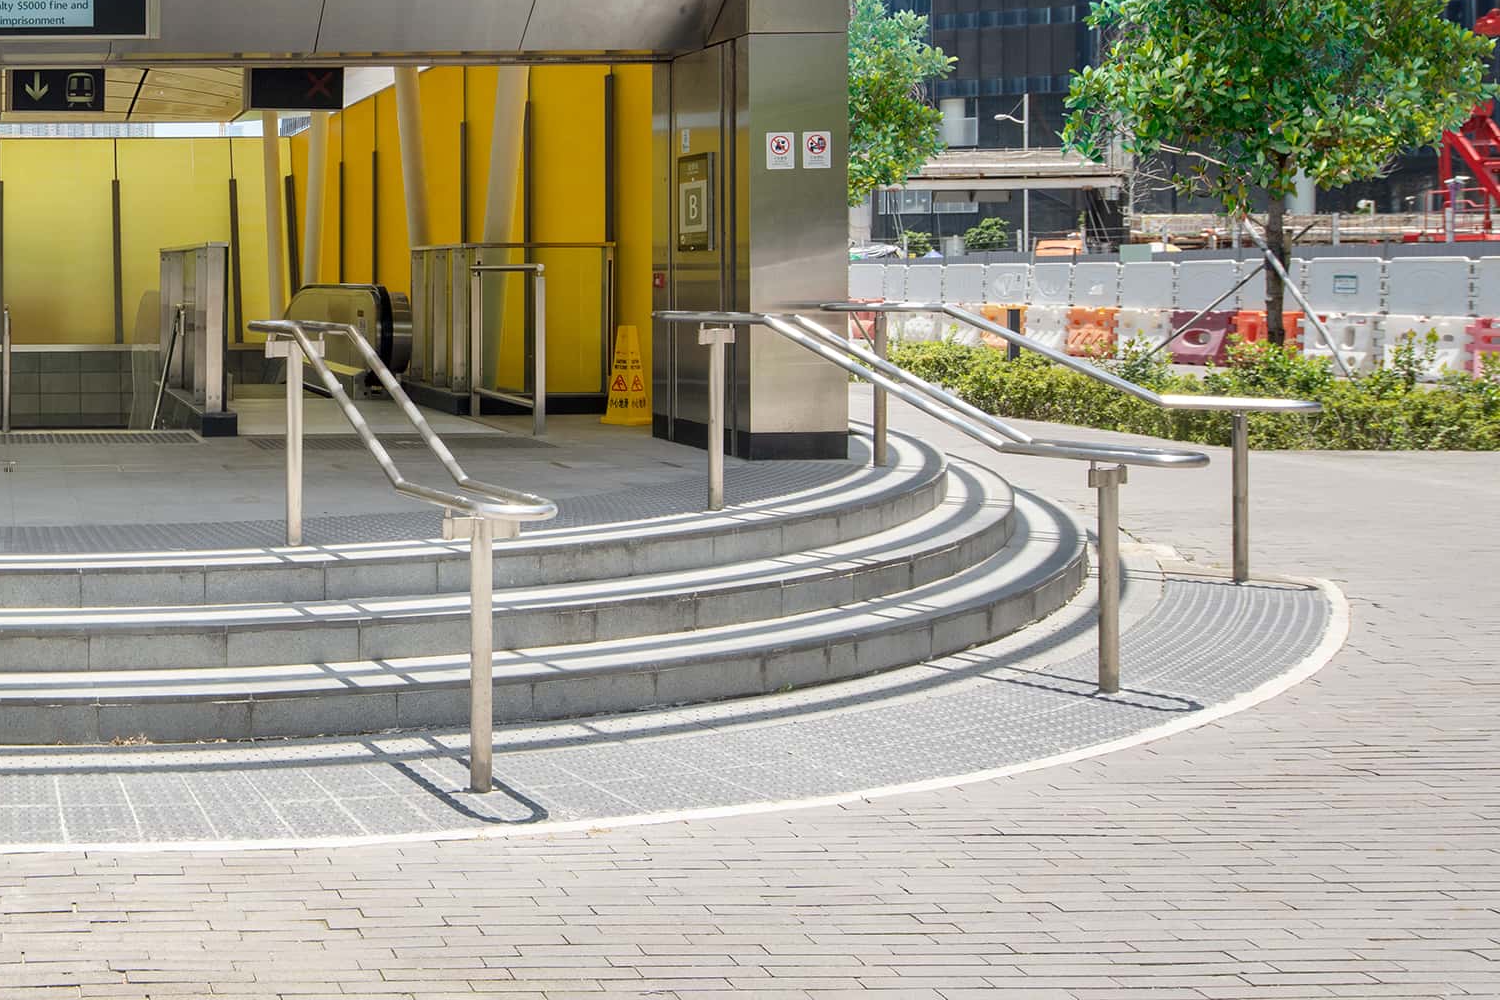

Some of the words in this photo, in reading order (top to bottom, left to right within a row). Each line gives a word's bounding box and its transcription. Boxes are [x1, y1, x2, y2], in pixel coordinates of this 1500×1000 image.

[49, 0, 69, 10] fine
[71, 0, 89, 10] and
[0, 15, 65, 28] imprisonment
[689, 194, 698, 220] B
